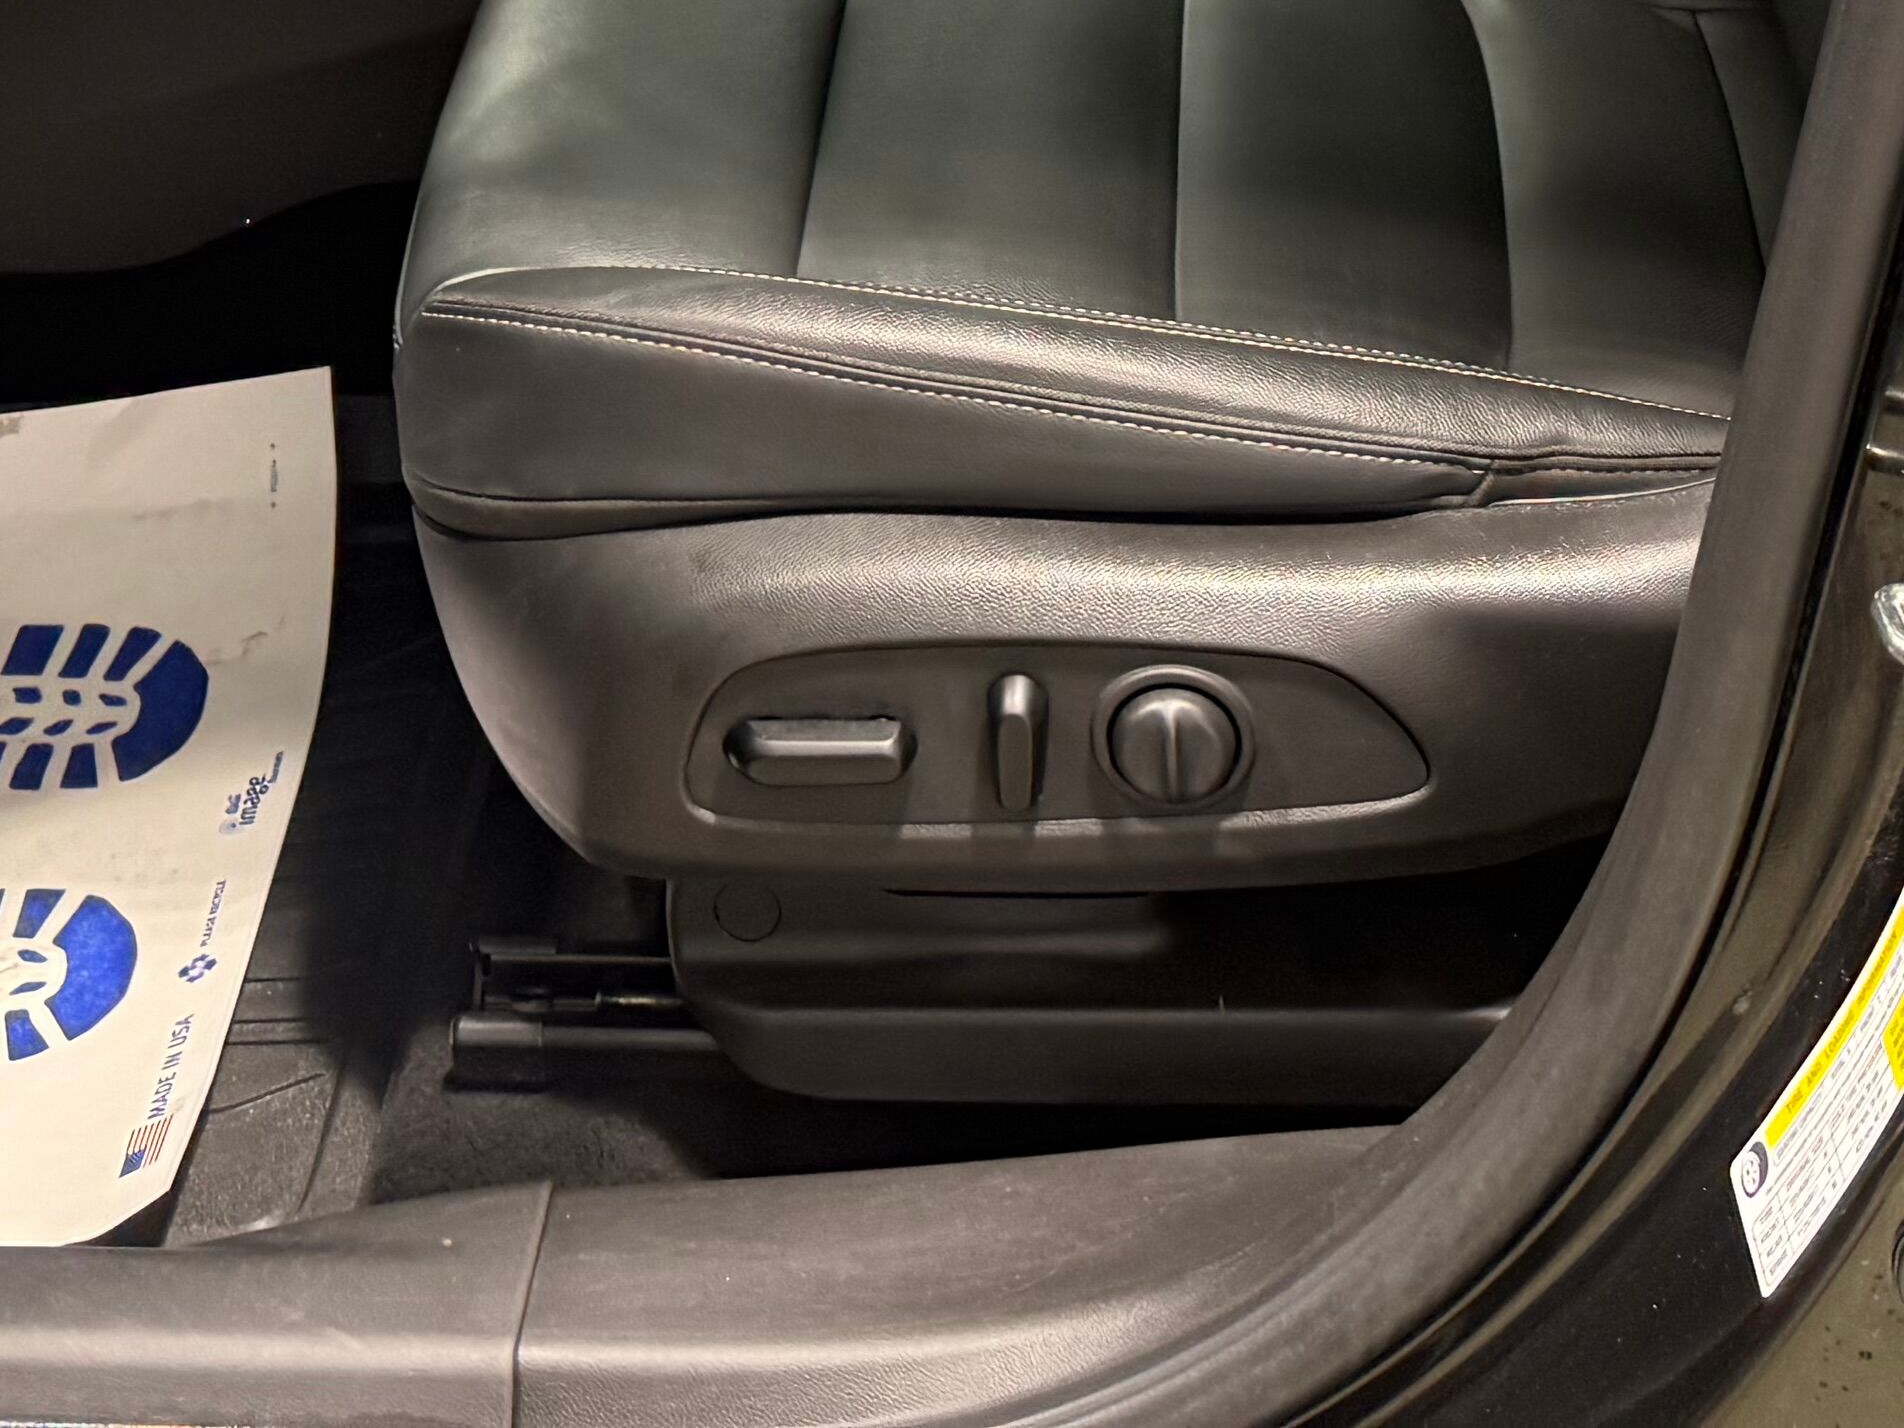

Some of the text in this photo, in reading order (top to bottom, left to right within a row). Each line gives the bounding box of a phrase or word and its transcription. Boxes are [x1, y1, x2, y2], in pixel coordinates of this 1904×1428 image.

[148, 1013, 194, 1120] MADE IN USA
